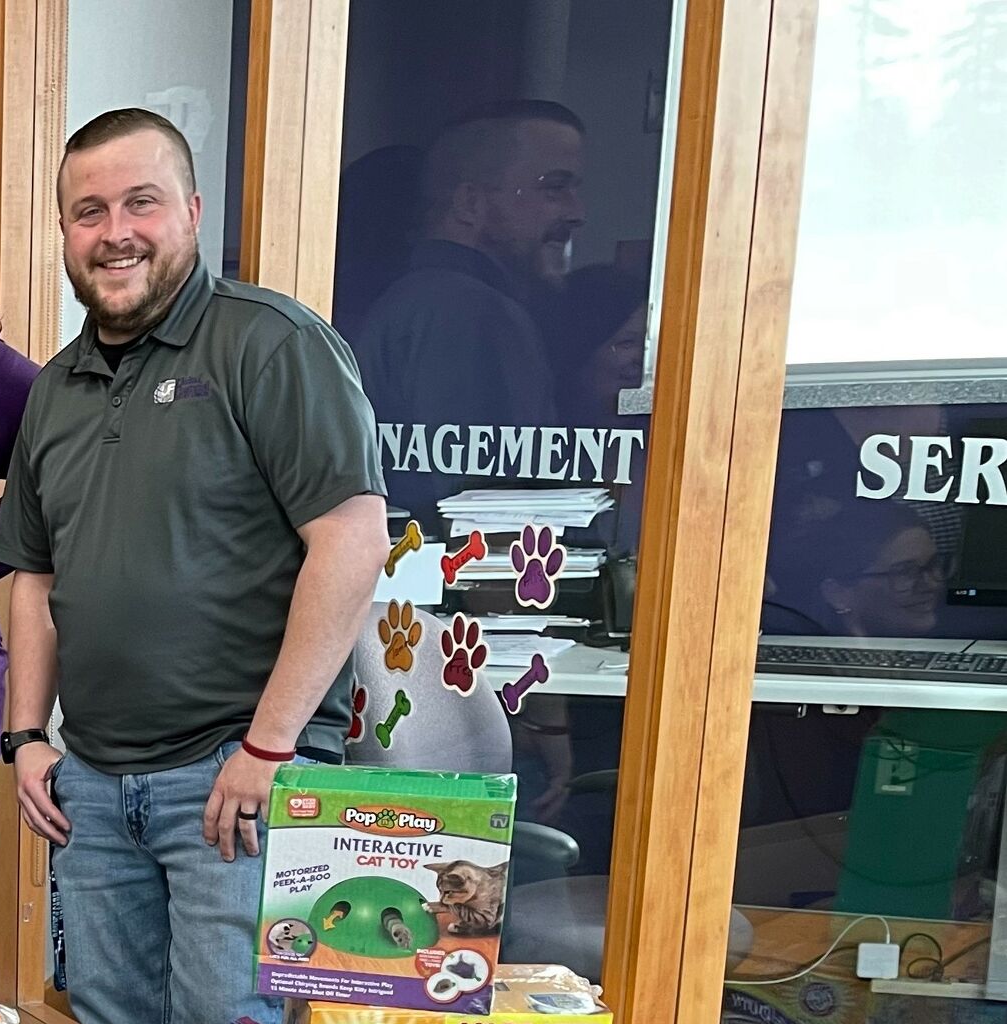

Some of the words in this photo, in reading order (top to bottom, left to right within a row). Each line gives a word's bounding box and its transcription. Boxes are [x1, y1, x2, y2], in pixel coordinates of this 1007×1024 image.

[345, 807, 376, 824] Pop
[398, 810, 437, 831] Play
[492, 816, 508, 828] TV
[333, 837, 443, 858] INTERACTIVE
[356, 855, 386, 868] CAT
[389, 857, 419, 870] TOY
[275, 863, 330, 880] MOTORIZED
[273, 872, 331, 888] PEEK-A-BOO
[289, 883, 313, 894] PLAY
